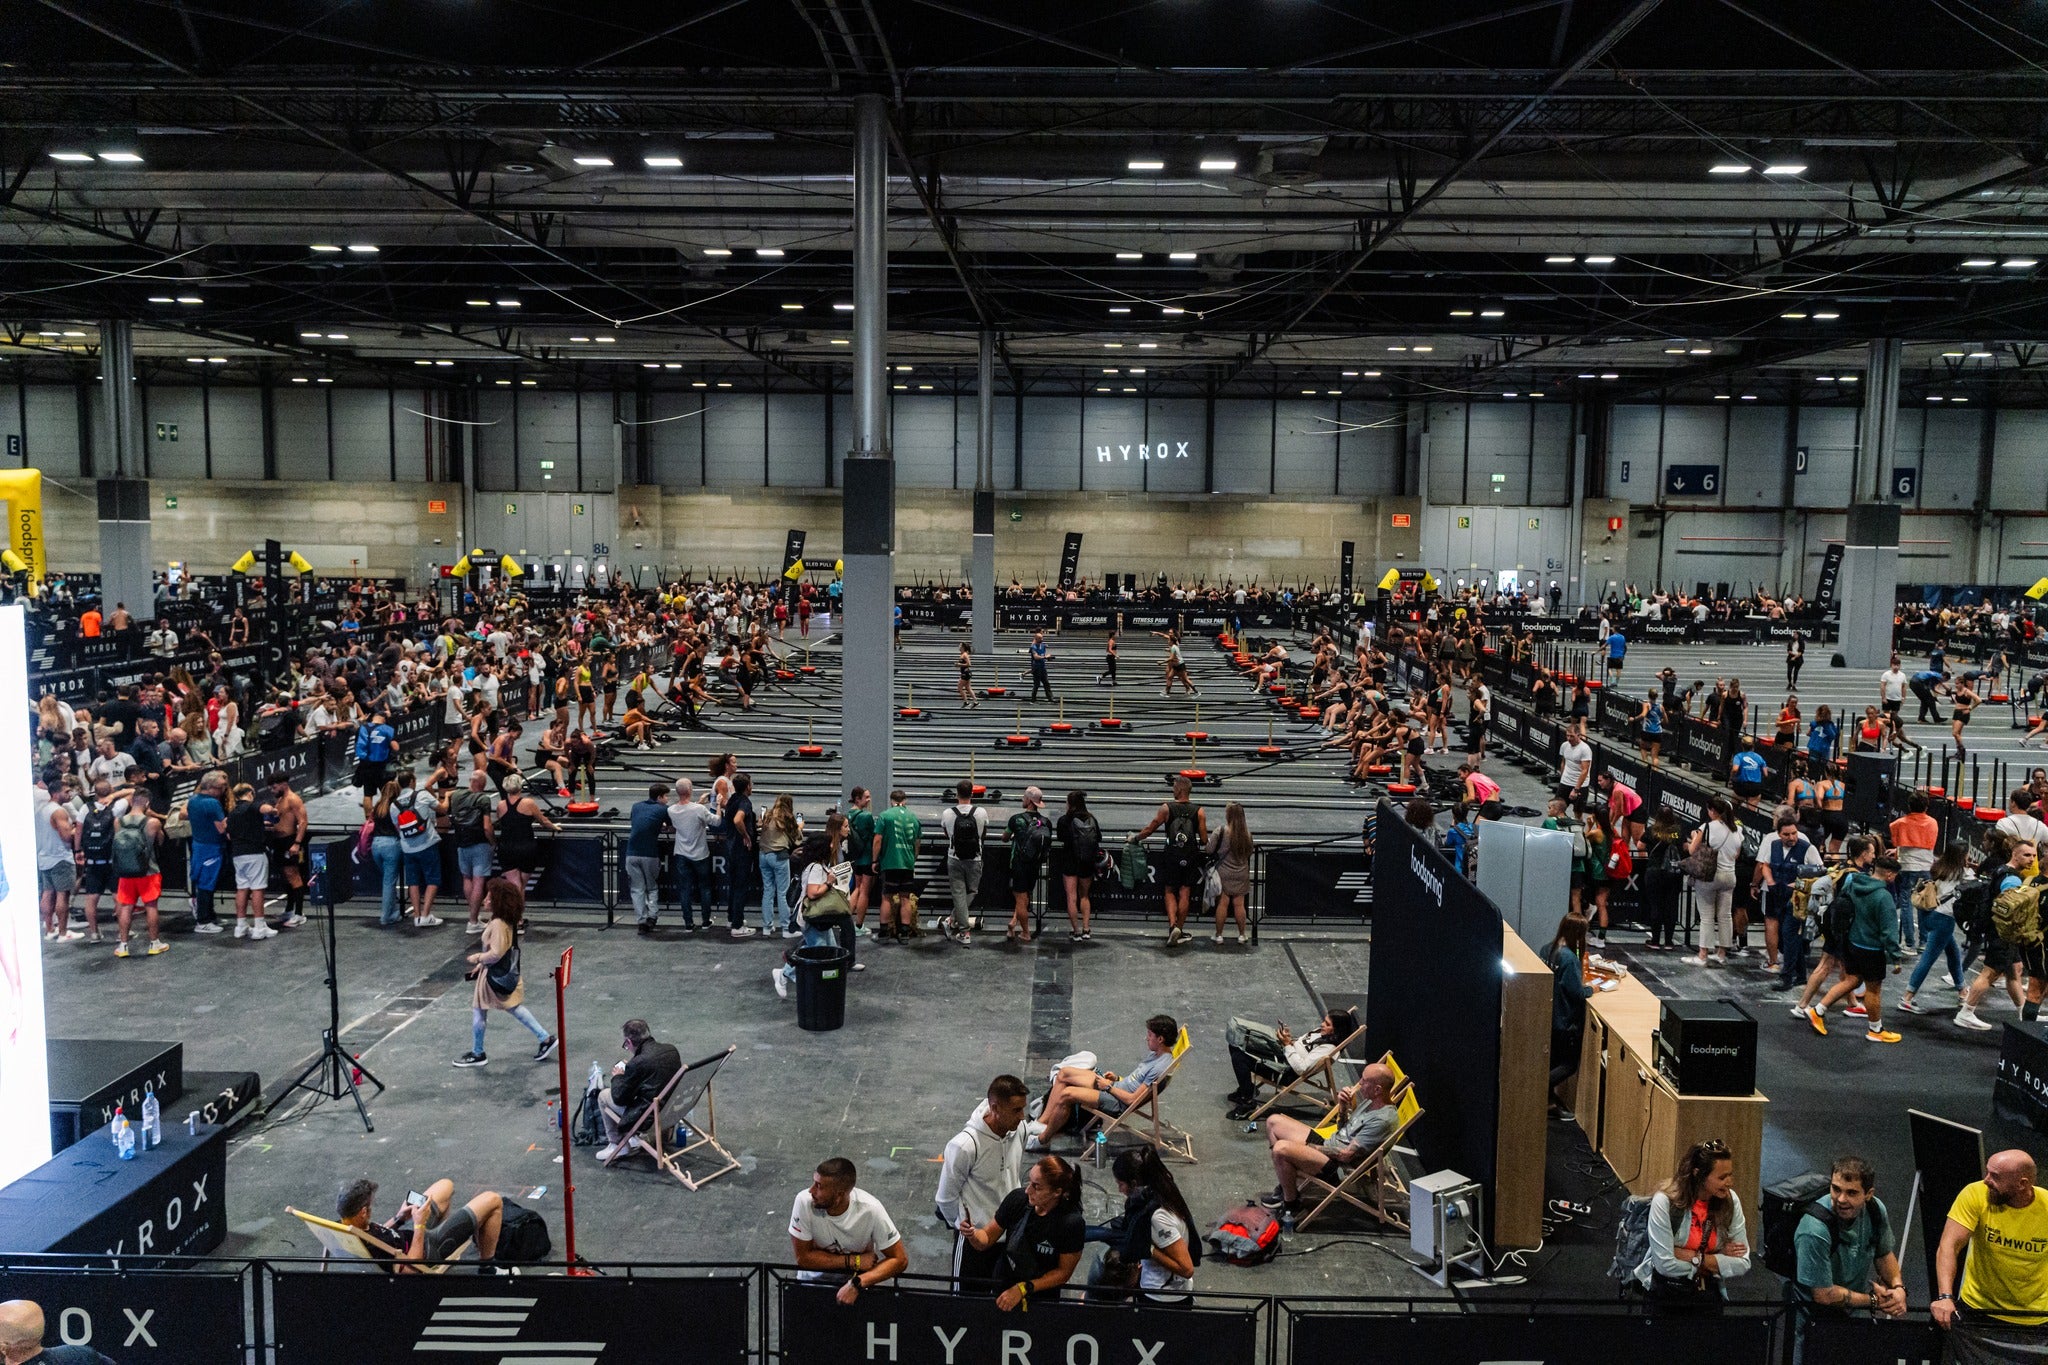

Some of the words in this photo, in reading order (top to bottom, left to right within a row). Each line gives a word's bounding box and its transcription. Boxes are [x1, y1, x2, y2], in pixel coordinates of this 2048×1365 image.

[10, 438, 17, 453] E
[1096, 442, 1189, 462] HYROX
[1796, 451, 1805, 471] D
[1622, 465, 1628, 479] E
[1703, 475, 1715, 491] 6
[1898, 477, 1910, 493] 6
[20, 509, 38, 582] foodspring
[593, 543, 609, 554] 8b
[1063, 542, 1078, 586] HYRO
[1547, 558, 1562, 569] 8a
[1819, 553, 1840, 609] HYROX
[909, 609, 935, 617] HYROX
[1071, 616, 1093, 624] FITNESS
[1132, 617, 1154, 625] FITNESS
[1154, 617, 1169, 625] PARK
[1521, 622, 1562, 633] foodspring
[1645, 624, 1686, 635] foodspring
[1770, 626, 1812, 637] foodsping
[39, 678, 85, 696] HYROX
[397, 714, 431, 736] HYROX
[1689, 729, 1722, 760] foodspring
[256, 752, 307, 780] HYROX
[1623, 773, 1637, 789] PARK
[1660, 790, 1685, 811] FITNESS
[1684, 799, 1702, 819] PARK
[1411, 843, 1443, 908] foodspring
[1690, 1043, 1738, 1057] foodspring
[102, 1070, 167, 1124] HYROX
[1985, 1230, 2048, 1252] EAMWOLF
[60, 1306, 158, 1348] OX
[866, 1321, 1165, 1365] HYROX
